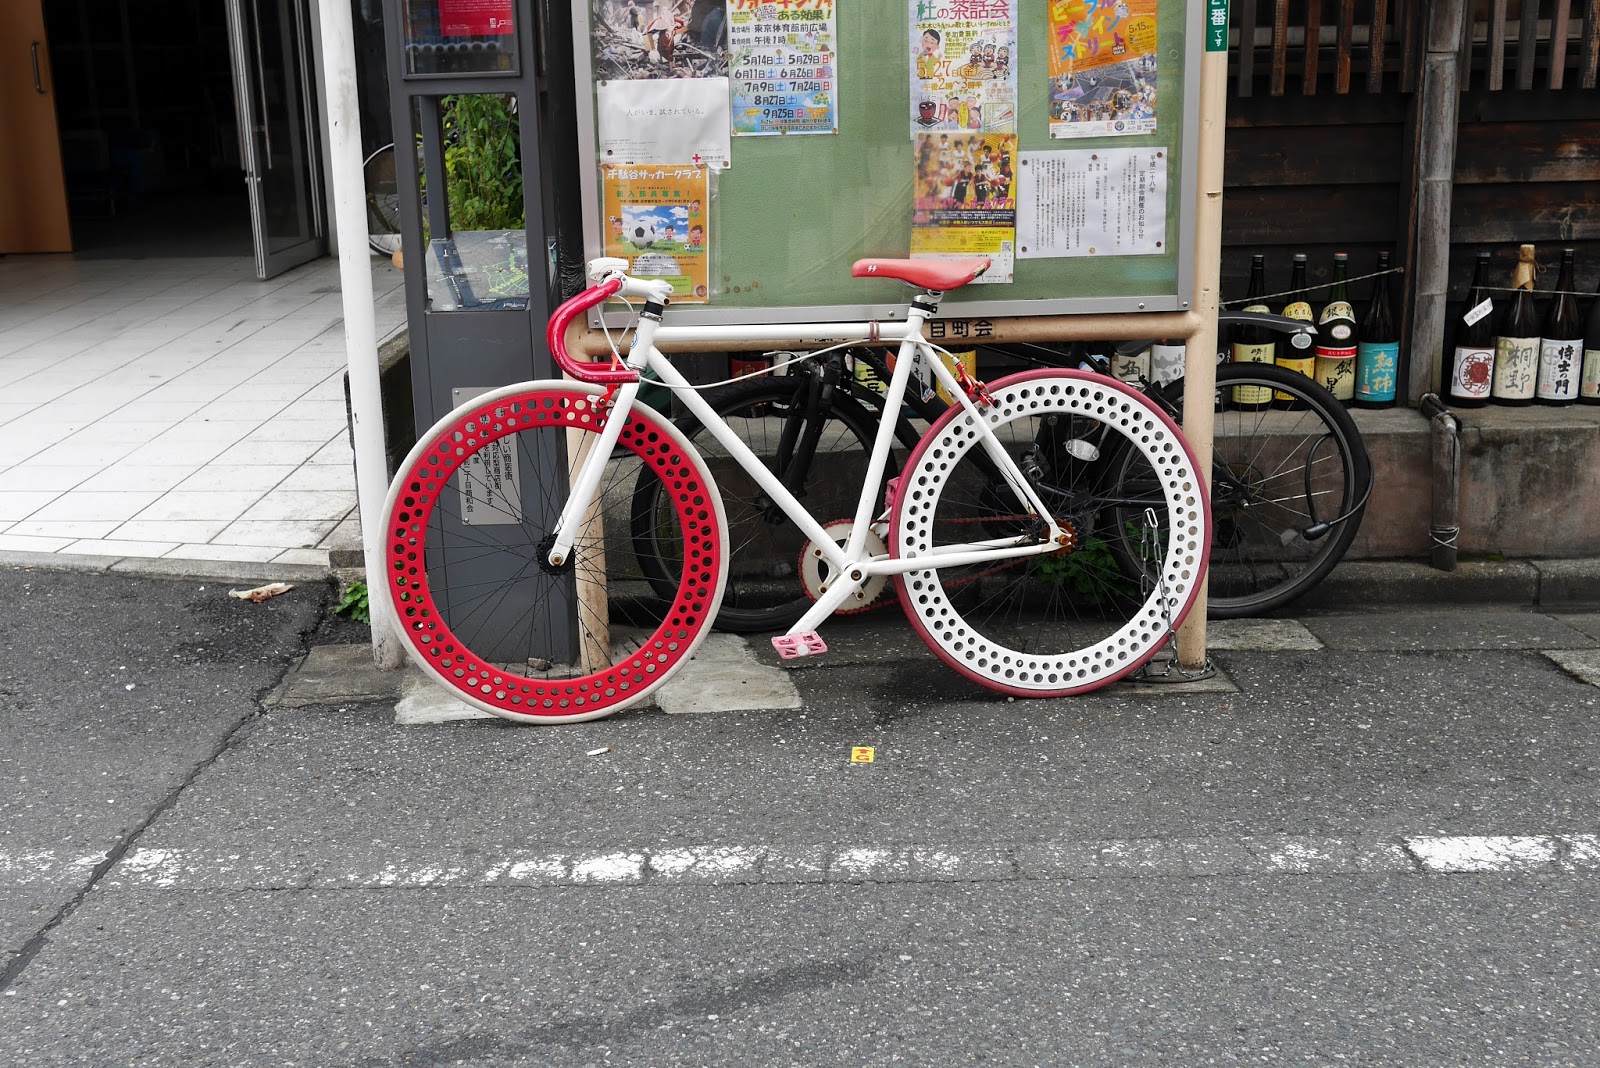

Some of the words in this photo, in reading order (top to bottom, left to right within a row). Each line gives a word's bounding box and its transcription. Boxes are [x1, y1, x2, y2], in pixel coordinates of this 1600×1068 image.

[754, 22, 828, 33] 東京体育館前広場
[754, 35, 787, 45] 午後1時
[607, 169, 703, 180] 千駄谷サッカークラブ
[1138, 170, 1146, 240] 定期総会開催のお知らせ
[930, 320, 993, 338] 目町会
[1554, 345, 1575, 395] 侍士の門
